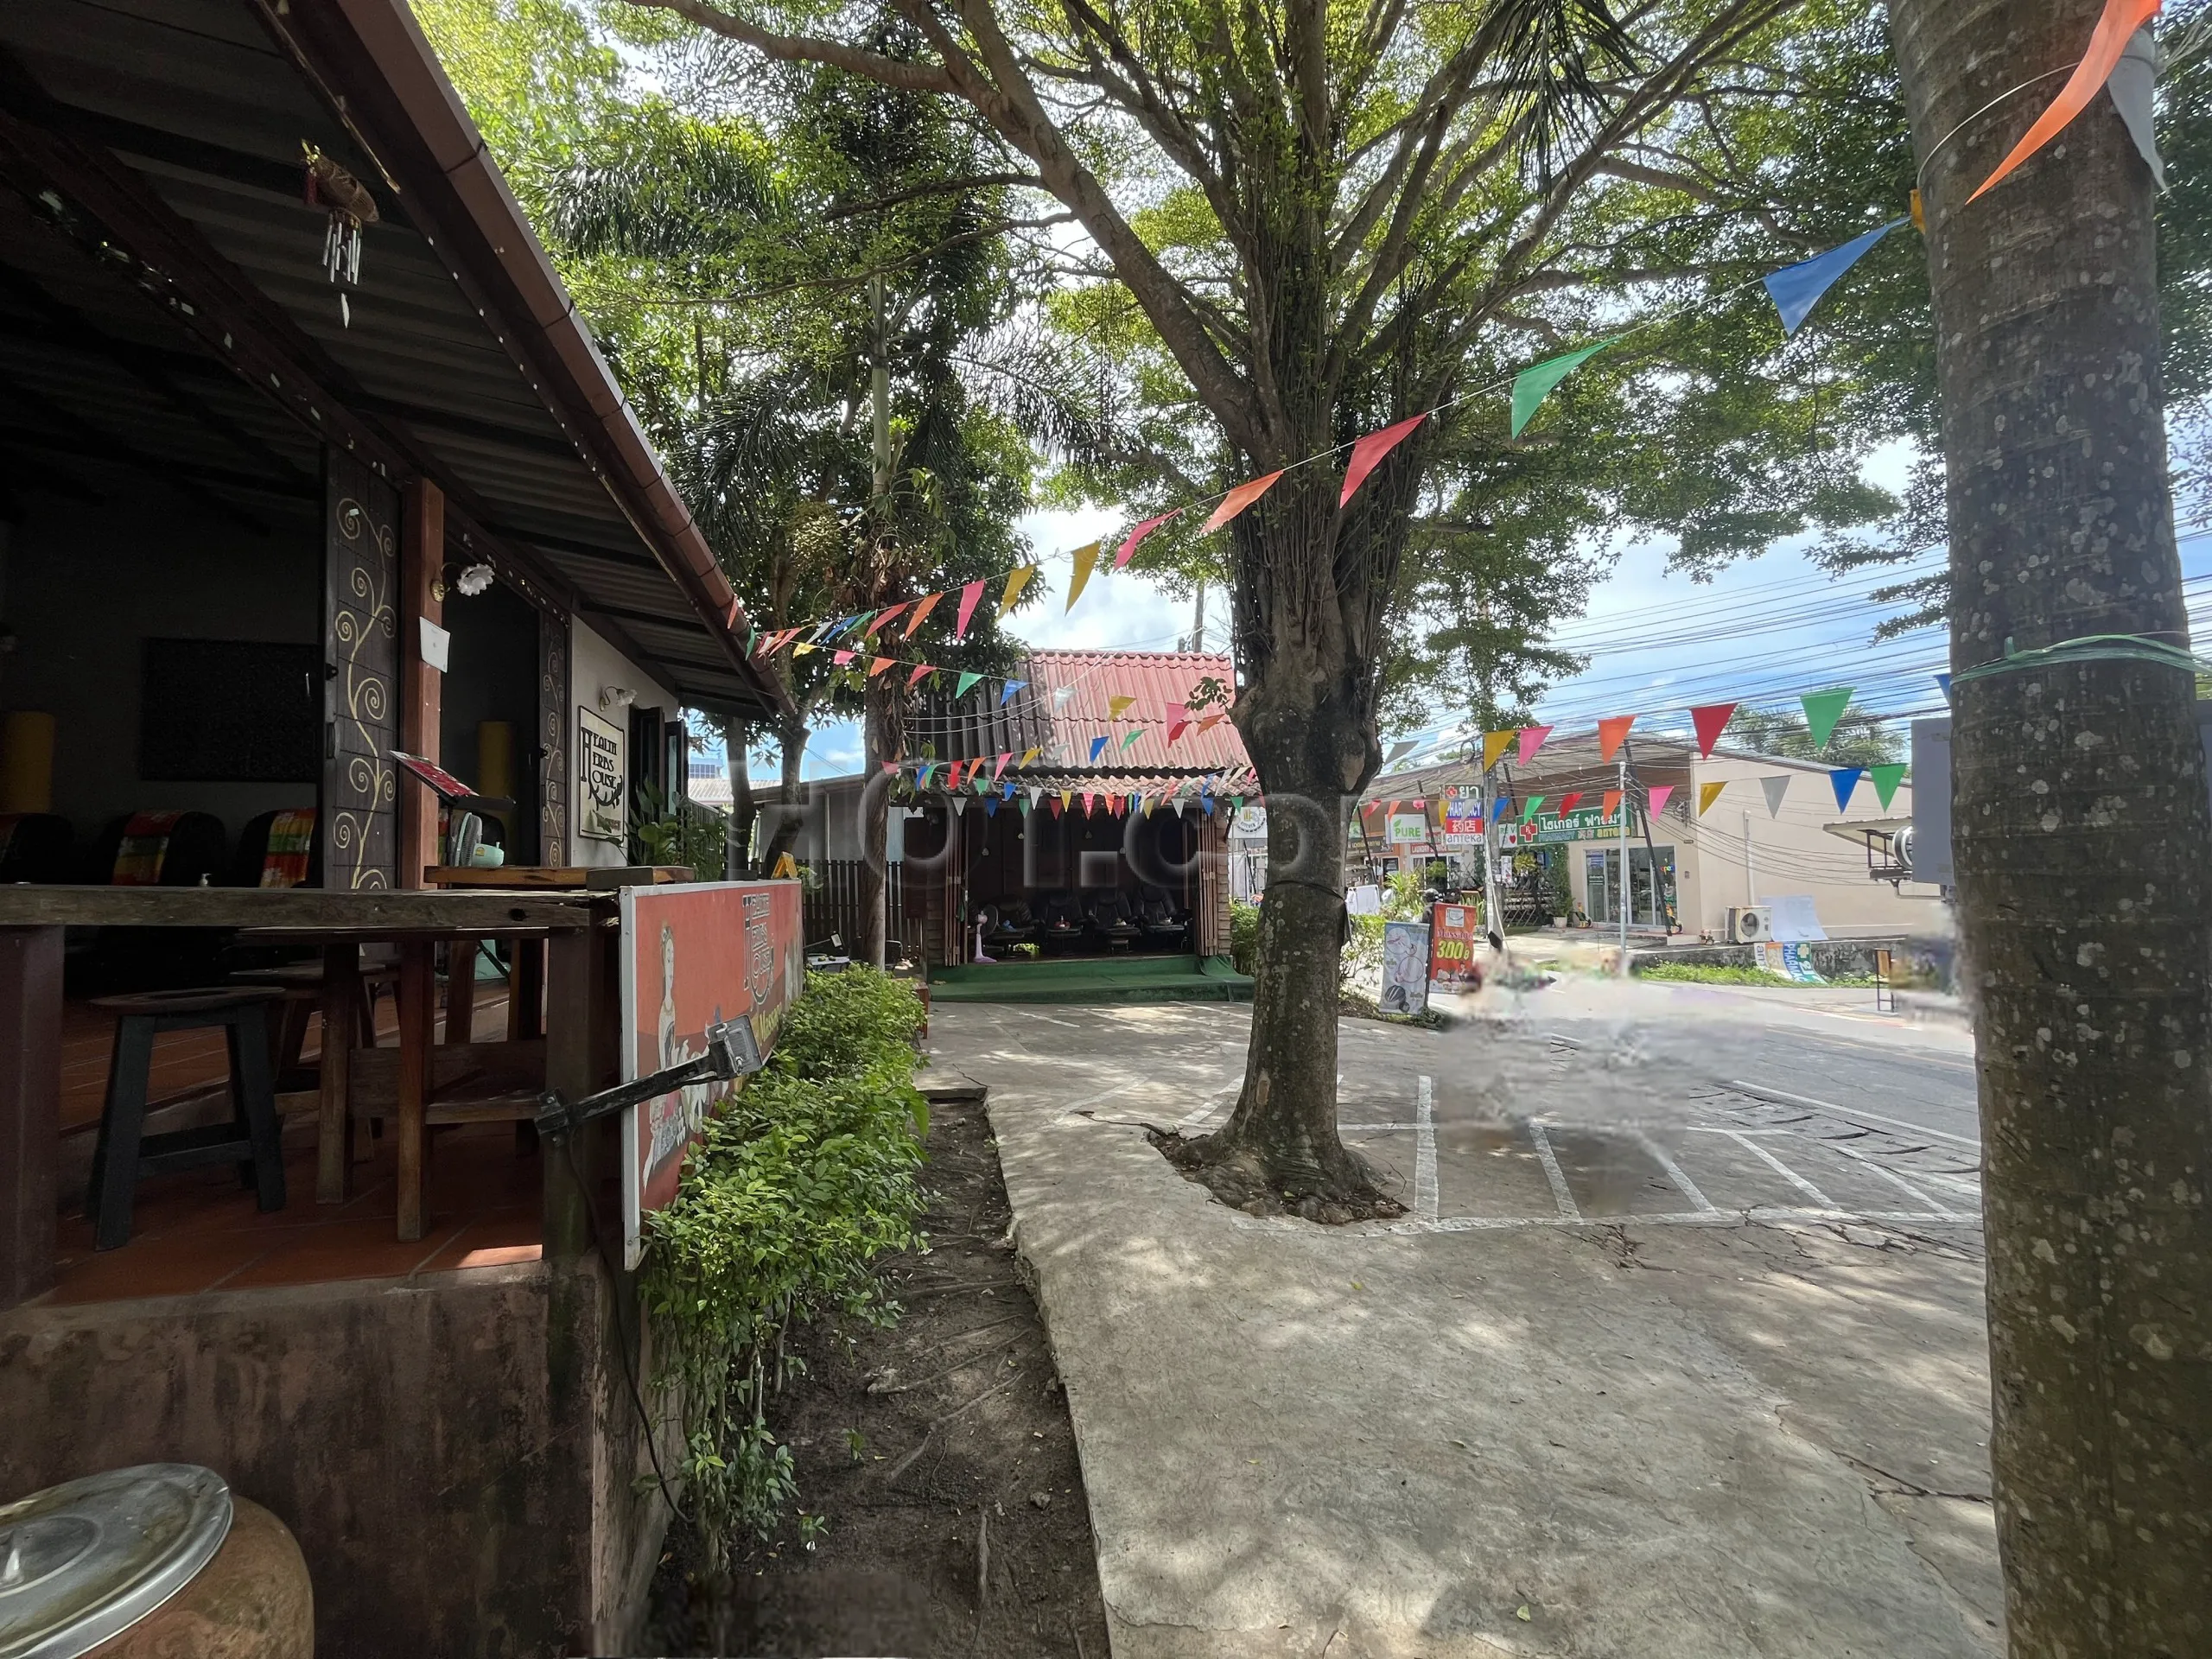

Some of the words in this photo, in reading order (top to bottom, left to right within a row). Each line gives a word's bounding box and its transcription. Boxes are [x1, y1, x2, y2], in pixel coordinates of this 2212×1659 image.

[1459, 785, 1479, 799] ยา
[1395, 827, 1421, 837] PURE
[1452, 820, 1476, 833] 药店
[1436, 927, 1473, 941] Massage
